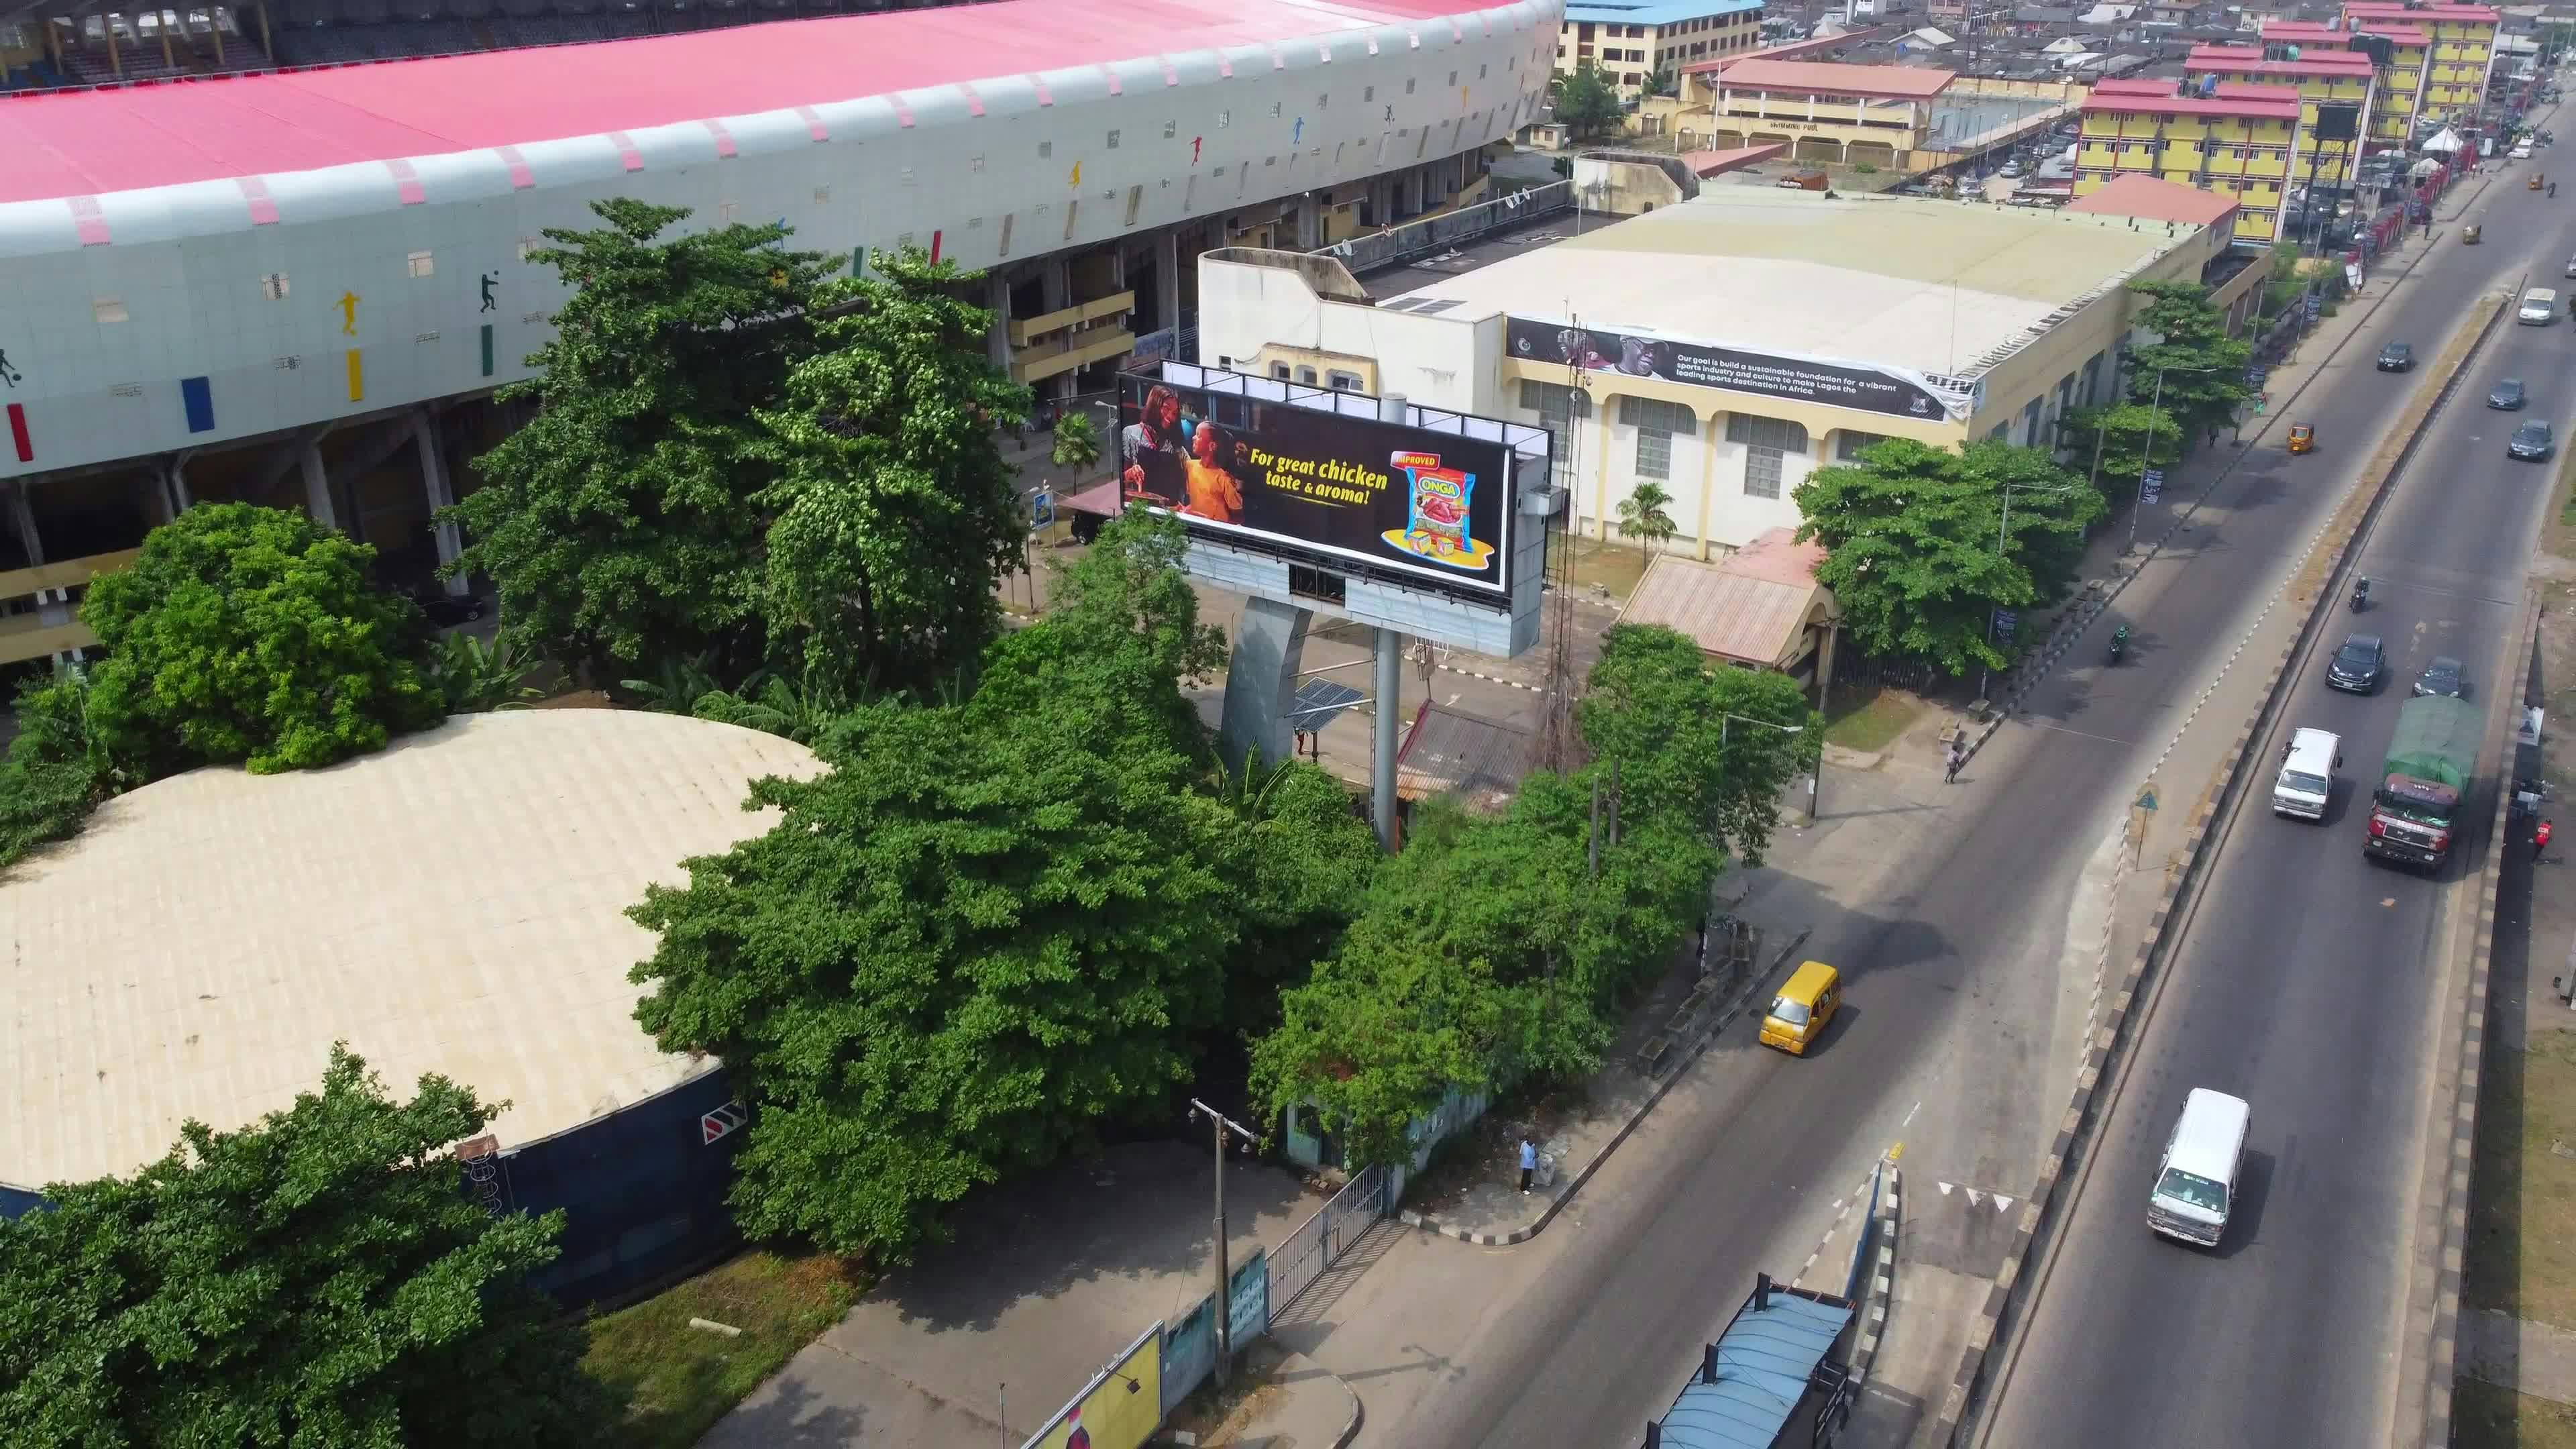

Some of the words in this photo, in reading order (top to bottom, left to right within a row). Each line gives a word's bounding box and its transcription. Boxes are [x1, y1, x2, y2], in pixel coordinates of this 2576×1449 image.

[1676, 370, 1705, 380] leading
[1707, 374, 1732, 383] sports
[1733, 377, 1778, 390] destination
[1779, 383, 1787, 391] in
[1677, 354, 1691, 362] Our
[1693, 357, 1711, 365] goal
[1720, 360, 1739, 369] build
[1748, 364, 1794, 376] sustainable
[1796, 371, 1841, 384] foundation
[1843, 378, 1856, 386] for
[1866, 381, 1897, 392] vibrant
[1677, 363, 1702, 372] sports
[1703, 364, 1734, 377] industry
[1735, 370, 1752, 378] and
[1753, 372, 1781, 382] culture
[1793, 379, 1815, 387] make
[1817, 382, 1841, 392] Lagos
[1843, 386, 1857, 394] the
[1250, 448, 1275, 466] For
[1276, 457, 1316, 476] great
[1318, 459, 1389, 490] chicken
[1396, 455, 1436, 466] IMPROVED
[1266, 470, 1301, 490] taste
[1304, 482, 1313, 494] &
[1316, 483, 1371, 505] aroma!
[1421, 480, 1456, 495] ONGA
